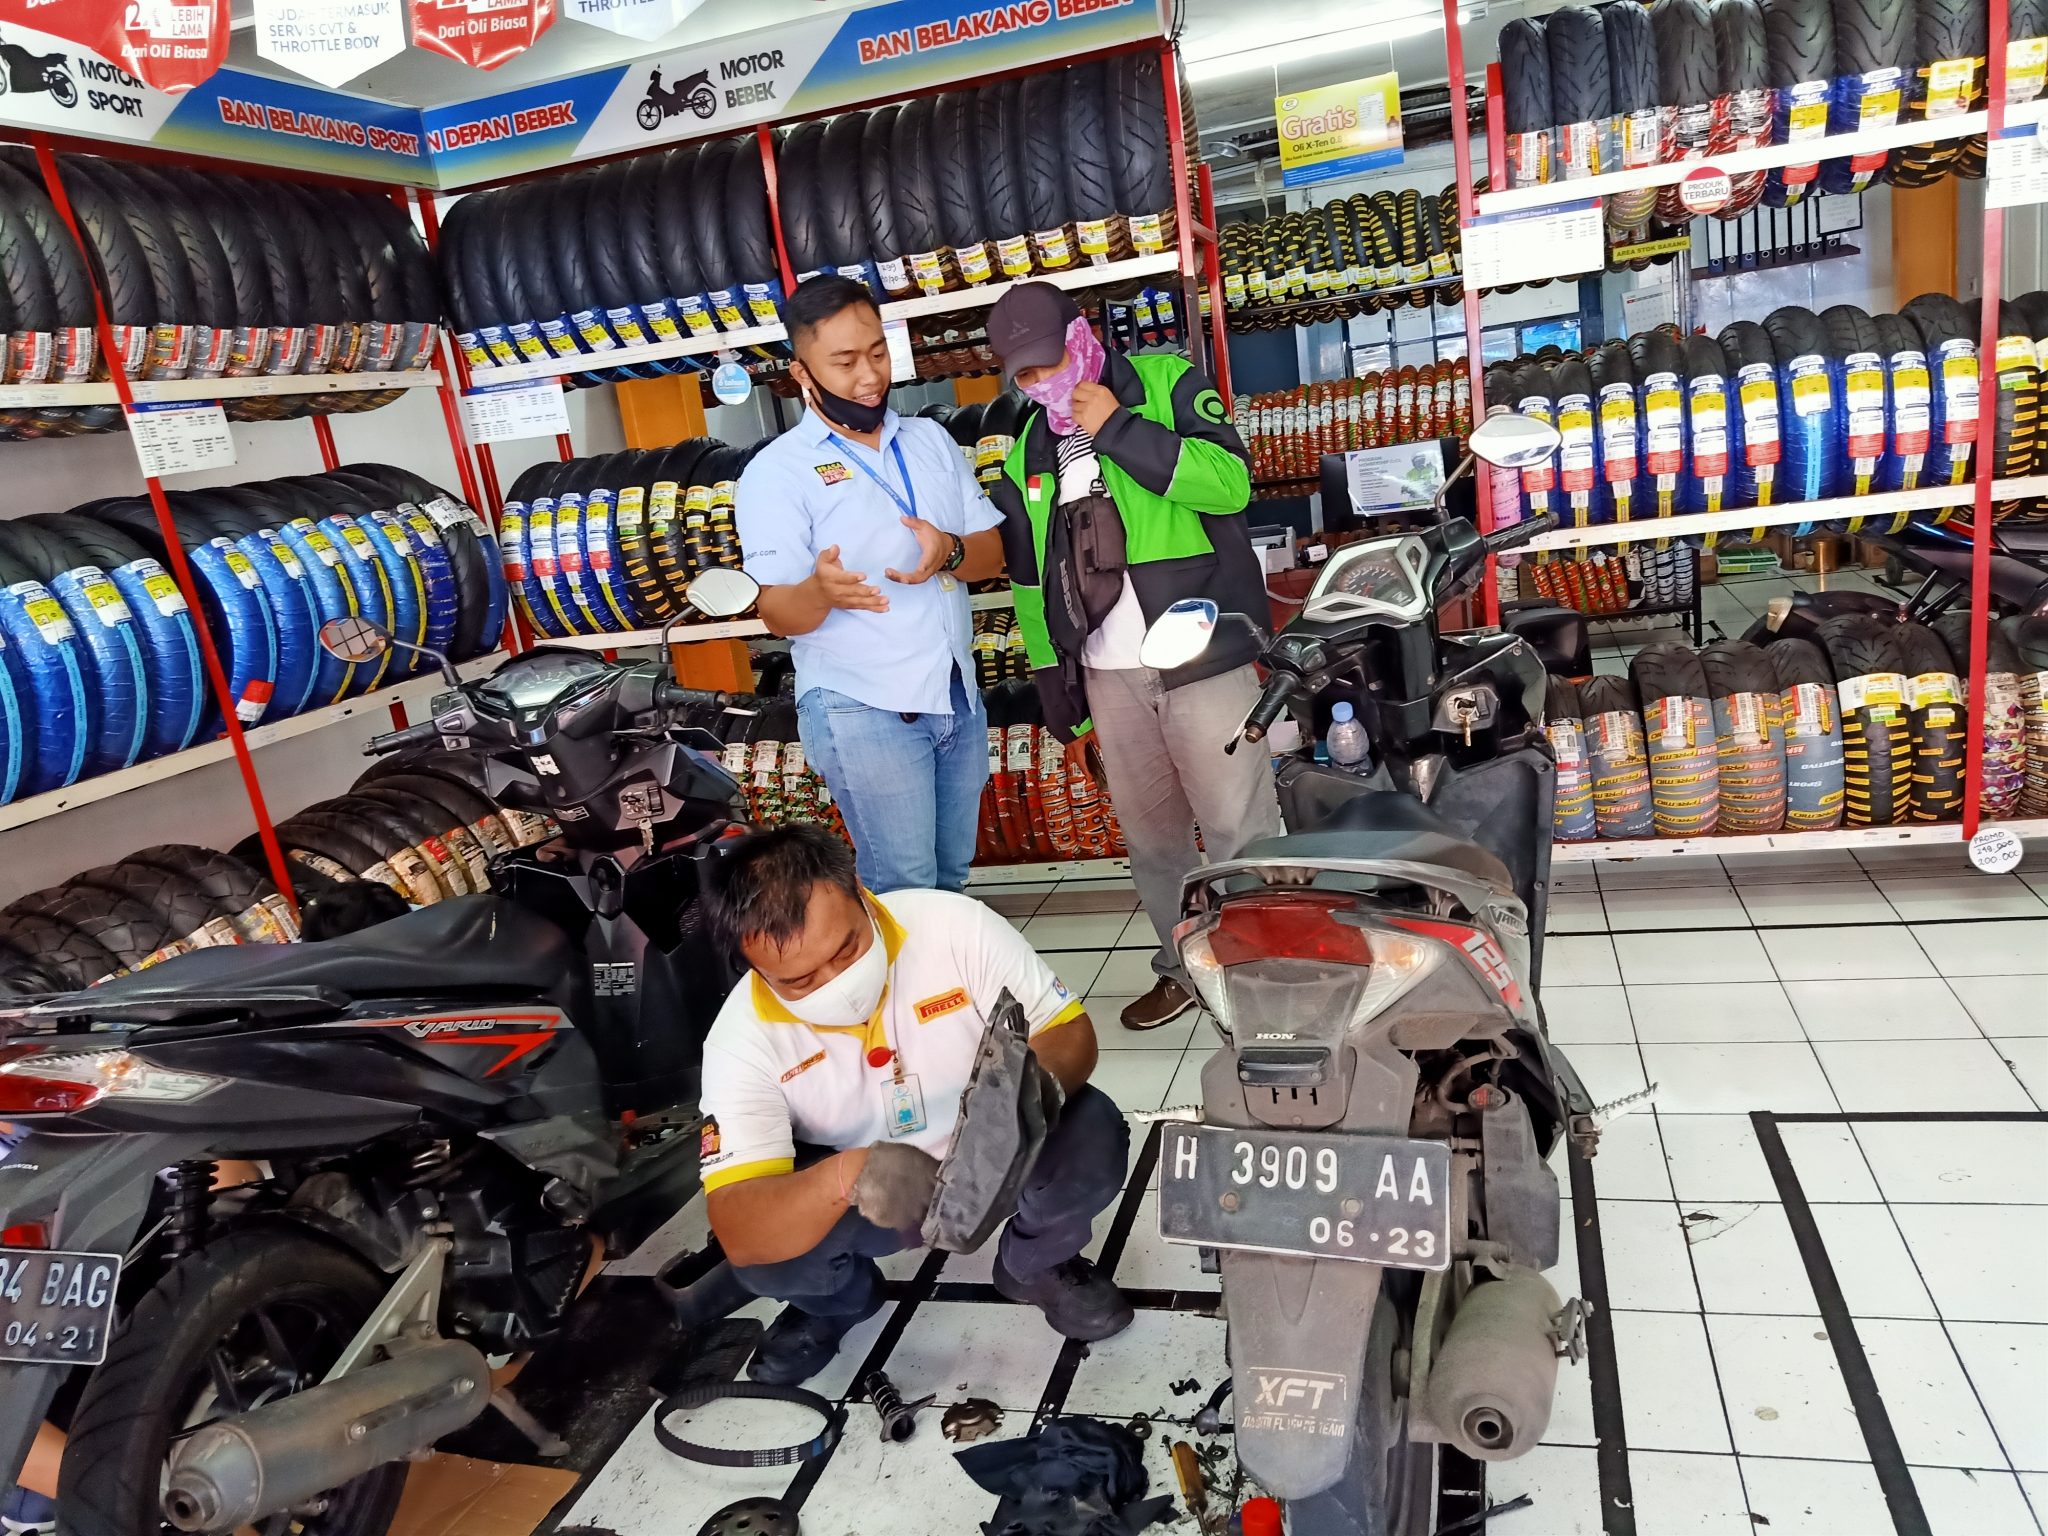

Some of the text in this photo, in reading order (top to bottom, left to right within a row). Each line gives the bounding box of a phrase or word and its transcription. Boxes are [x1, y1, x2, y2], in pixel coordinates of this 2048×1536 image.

[172, 23, 204, 36] LAMA
[269, 21, 357, 37] SERVIS CVT &
[438, 15, 528, 40] Dari Oli Biasa
[859, 31, 912, 63] BAN
[916, 5, 1050, 49] BELAKANG
[121, 44, 209, 59] Dari Oli Biasa
[271, 35, 380, 53] THROTTLE BODY
[720, 49, 786, 81] MOTOR
[87, 89, 144, 118] SPORT
[725, 80, 777, 109] BEBEK
[219, 97, 419, 156] BAN BELAKANG SPORT
[446, 116, 510, 149] DEPAN
[515, 101, 576, 134] BEBEK
[1282, 105, 1358, 140] Gratis
[1293, 143, 1305, 153] Oli
[1683, 187, 1730, 200] TERBARU
[1687, 180, 1724, 192] PRODUK
[1616, 240, 1687, 257] AREA STOK BARANG
[1974, 831, 2005, 844] PROMO
[1461, 930, 1514, 991] 125
[919, 992, 965, 1018] PIRELLI
[403, 1018, 498, 1038] VARIO
[1174, 1135, 1198, 1180] H
[1231, 1141, 1338, 1193] 3909
[41, 1262, 111, 1308] BAG
[1255, 1375, 1336, 1410] XFT
